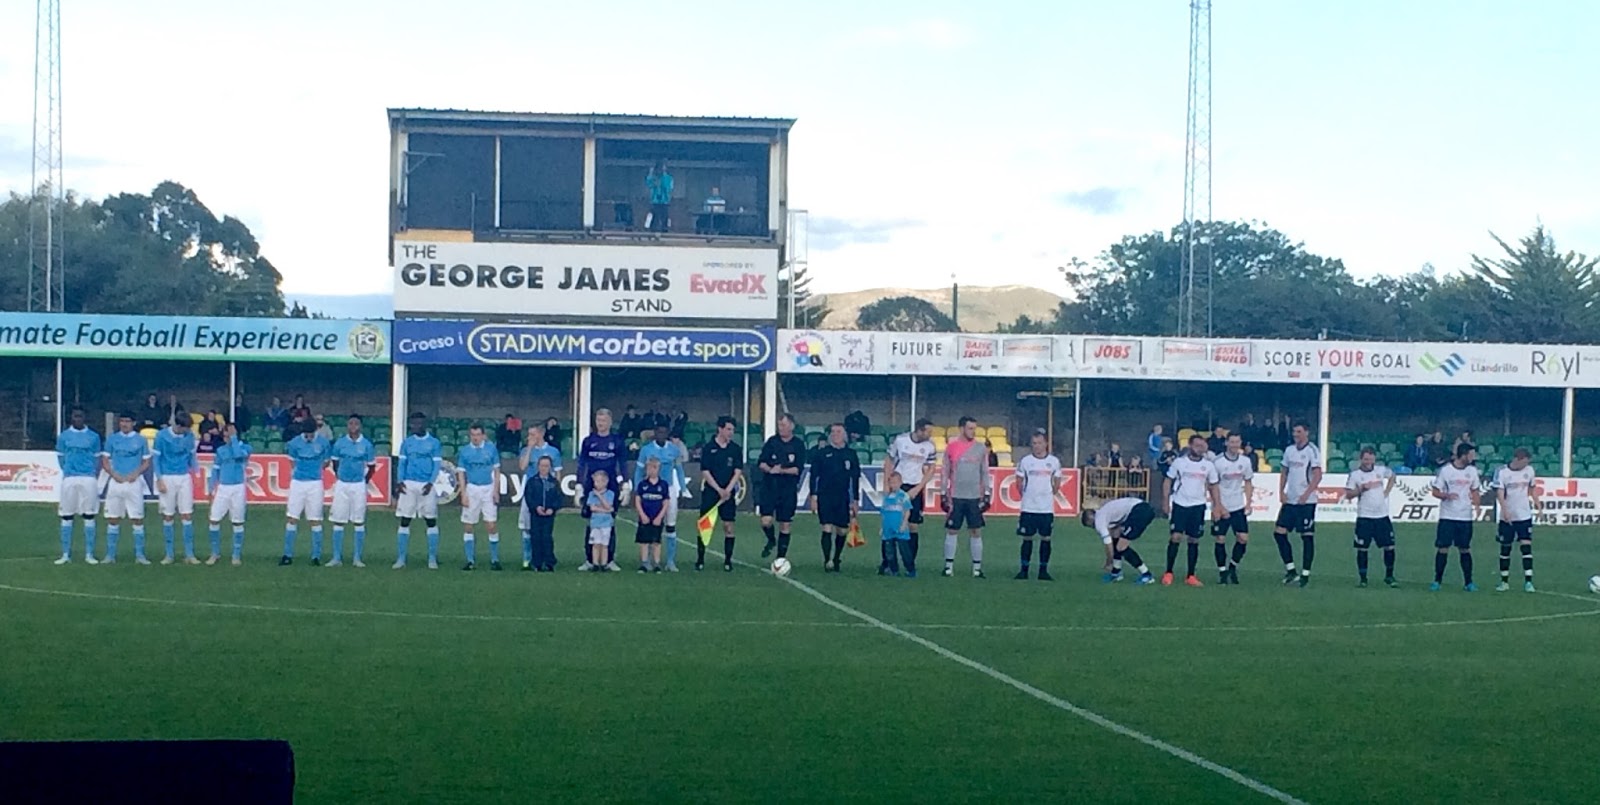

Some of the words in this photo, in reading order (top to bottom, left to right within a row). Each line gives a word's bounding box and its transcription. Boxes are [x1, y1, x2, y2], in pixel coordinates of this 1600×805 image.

[402, 244, 437, 260] THE
[400, 263, 544, 290] GEORGE
[557, 267, 671, 292] JAMES
[690, 273, 767, 294] EvadX
[610, 298, 672, 313] STAND
[75, 322, 187, 348] Football
[194, 324, 339, 355] Experience
[399, 338, 455, 354] Croeso
[457, 331, 464, 346] i
[479, 333, 586, 355] STADIWM
[588, 332, 691, 356] corbett
[693, 340, 760, 361] sports
[892, 341, 943, 357] FUTURE
[1093, 345, 1132, 359] JOBS
[1214, 355, 1248, 365] BUILD
[1263, 350, 1311, 366] SCORE
[1317, 349, 1365, 368] YOUR
[1370, 353, 1411, 369] GOAL
[1470, 362, 1519, 373] Llandrillo
[1392, 504, 1439, 520] FBT
[1529, 500, 1595, 510] OOFING
